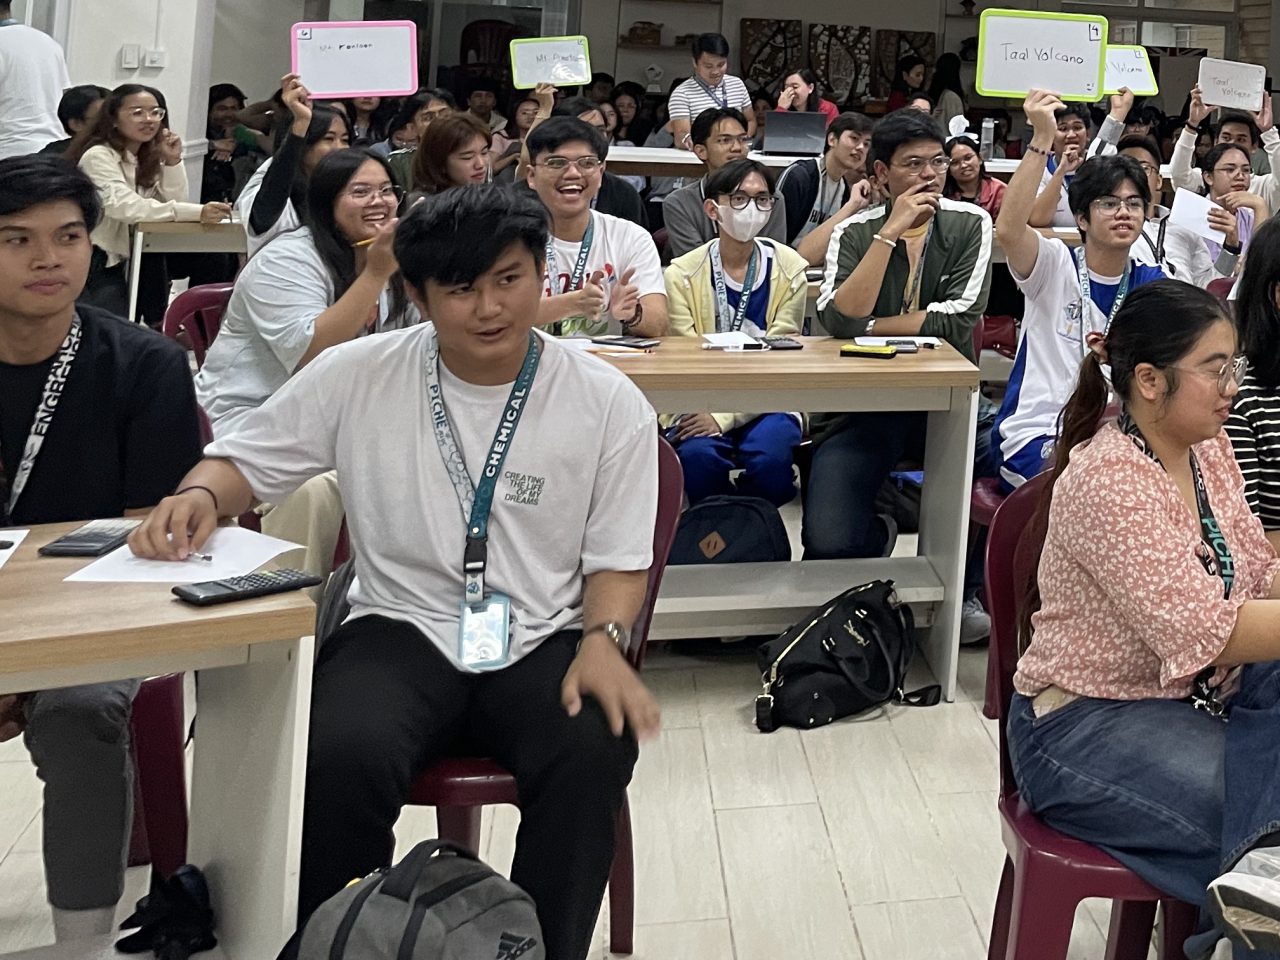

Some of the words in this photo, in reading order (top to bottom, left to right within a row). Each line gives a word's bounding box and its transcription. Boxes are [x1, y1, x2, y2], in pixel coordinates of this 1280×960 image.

[1092, 25, 1099, 36] 4
[1000, 42, 1029, 61] Taal
[1034, 46, 1084, 64] Volcano
[1210, 77, 1229, 88] Taal
[1080, 272, 1091, 299] PICHE
[429, 383, 447, 429] PICHE
[486, 388, 526, 478] CHEMICAL
[505, 471, 545, 485] CREATING
[510, 479, 526, 490] THE
[526, 482, 543, 492] LIFE
[505, 493, 539, 506] DREAMS
[516, 488, 528, 497] OF
[528, 489, 542, 498] MY
